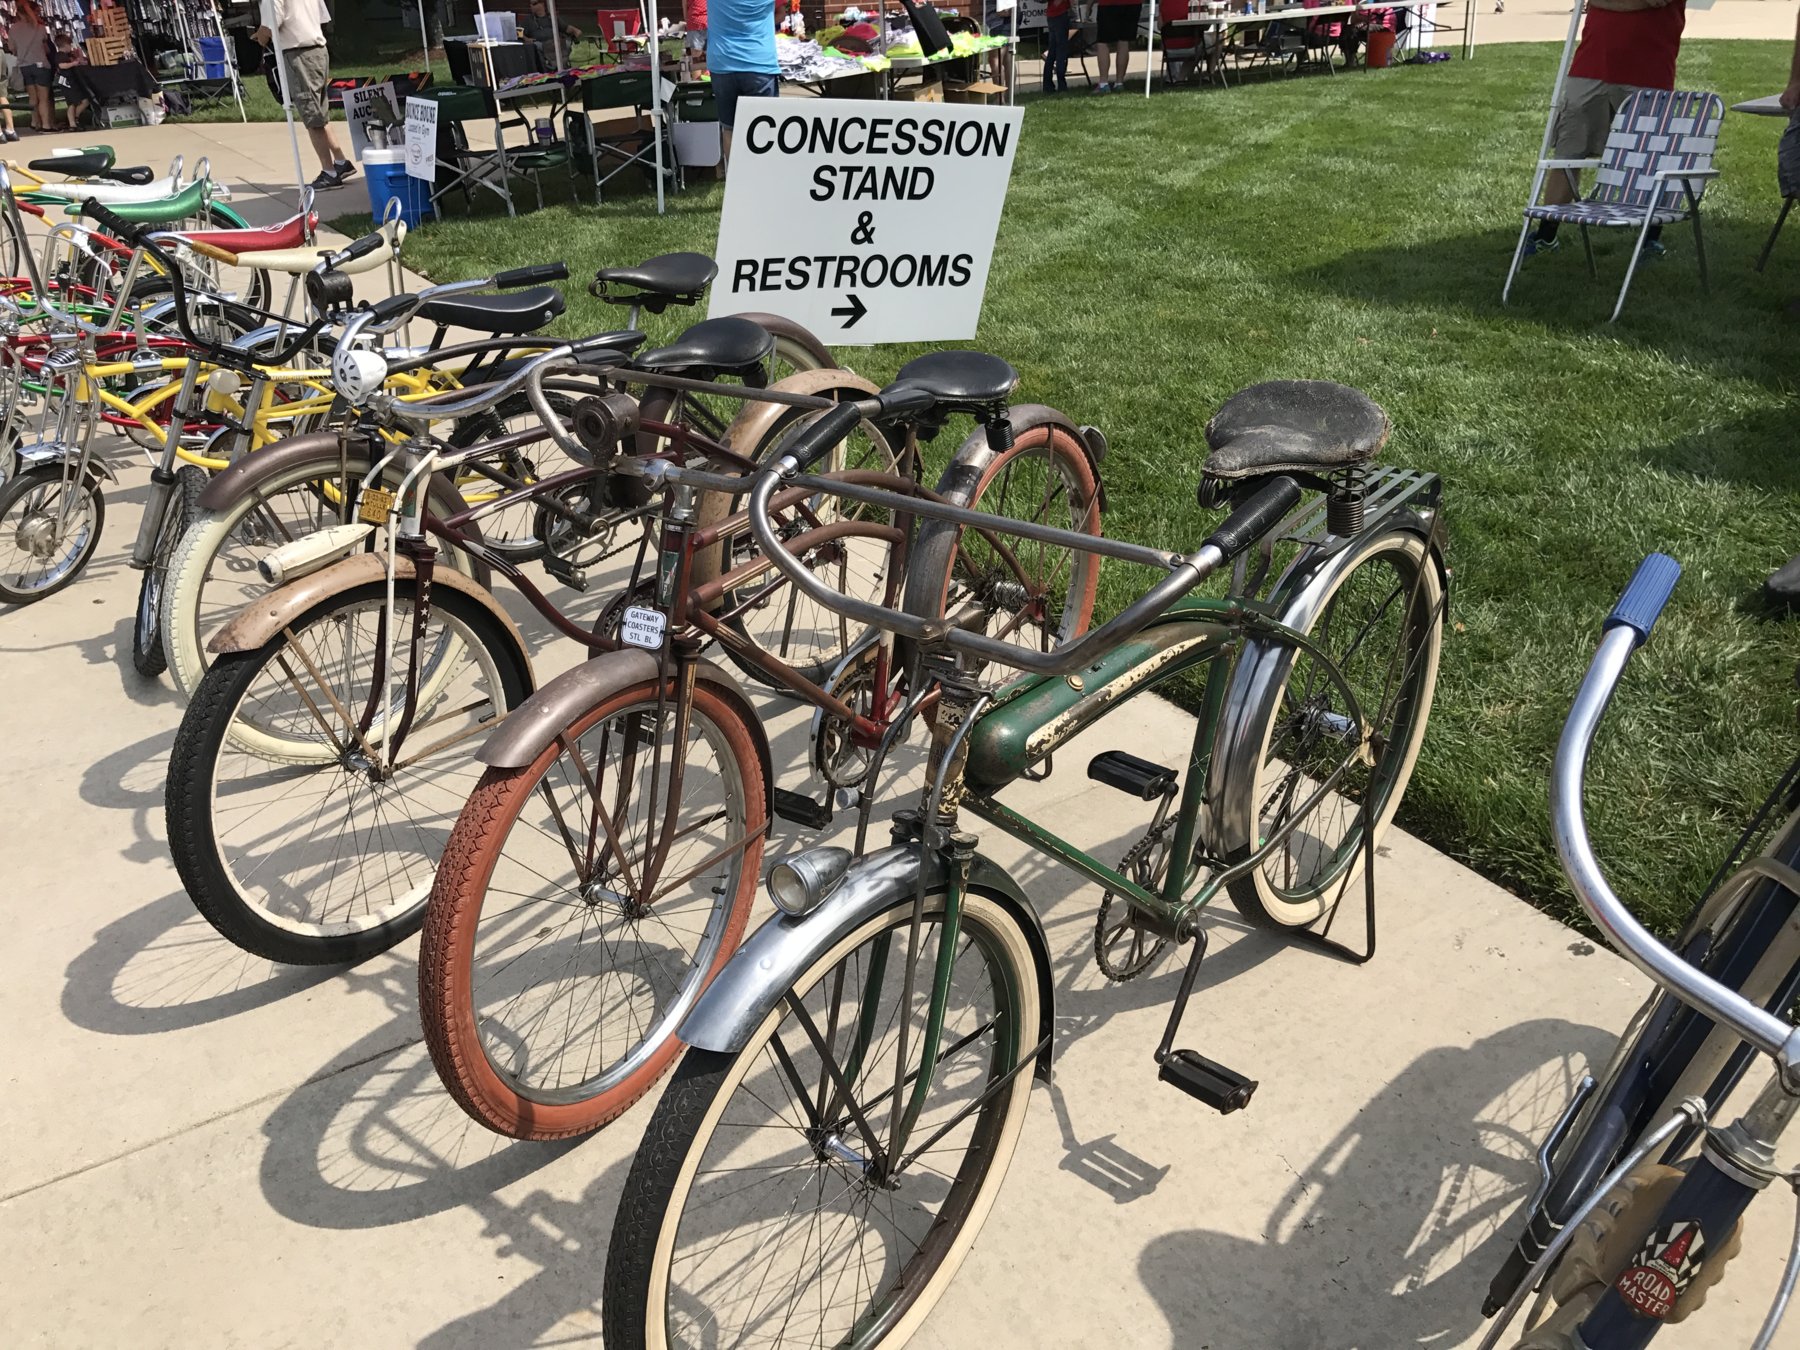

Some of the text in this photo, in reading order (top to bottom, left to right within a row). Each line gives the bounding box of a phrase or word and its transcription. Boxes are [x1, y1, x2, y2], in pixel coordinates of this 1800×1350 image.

[1022, 9, 1048, 17] ROOMS
[353, 86, 385, 104] SILENT
[420, 104, 436, 124] HOUSE
[746, 115, 1011, 157] CONCESSION
[809, 164, 935, 201] STAND
[850, 210, 876, 245] &
[732, 253, 974, 293] RESTROOMS
[627, 621, 659, 635] COASTERS
[630, 610, 660, 623] GATEWAY
[629, 632, 653, 644] STL BL
[1619, 1275, 1670, 1315] MASTER
[1633, 1271, 1670, 1301] ROAD
